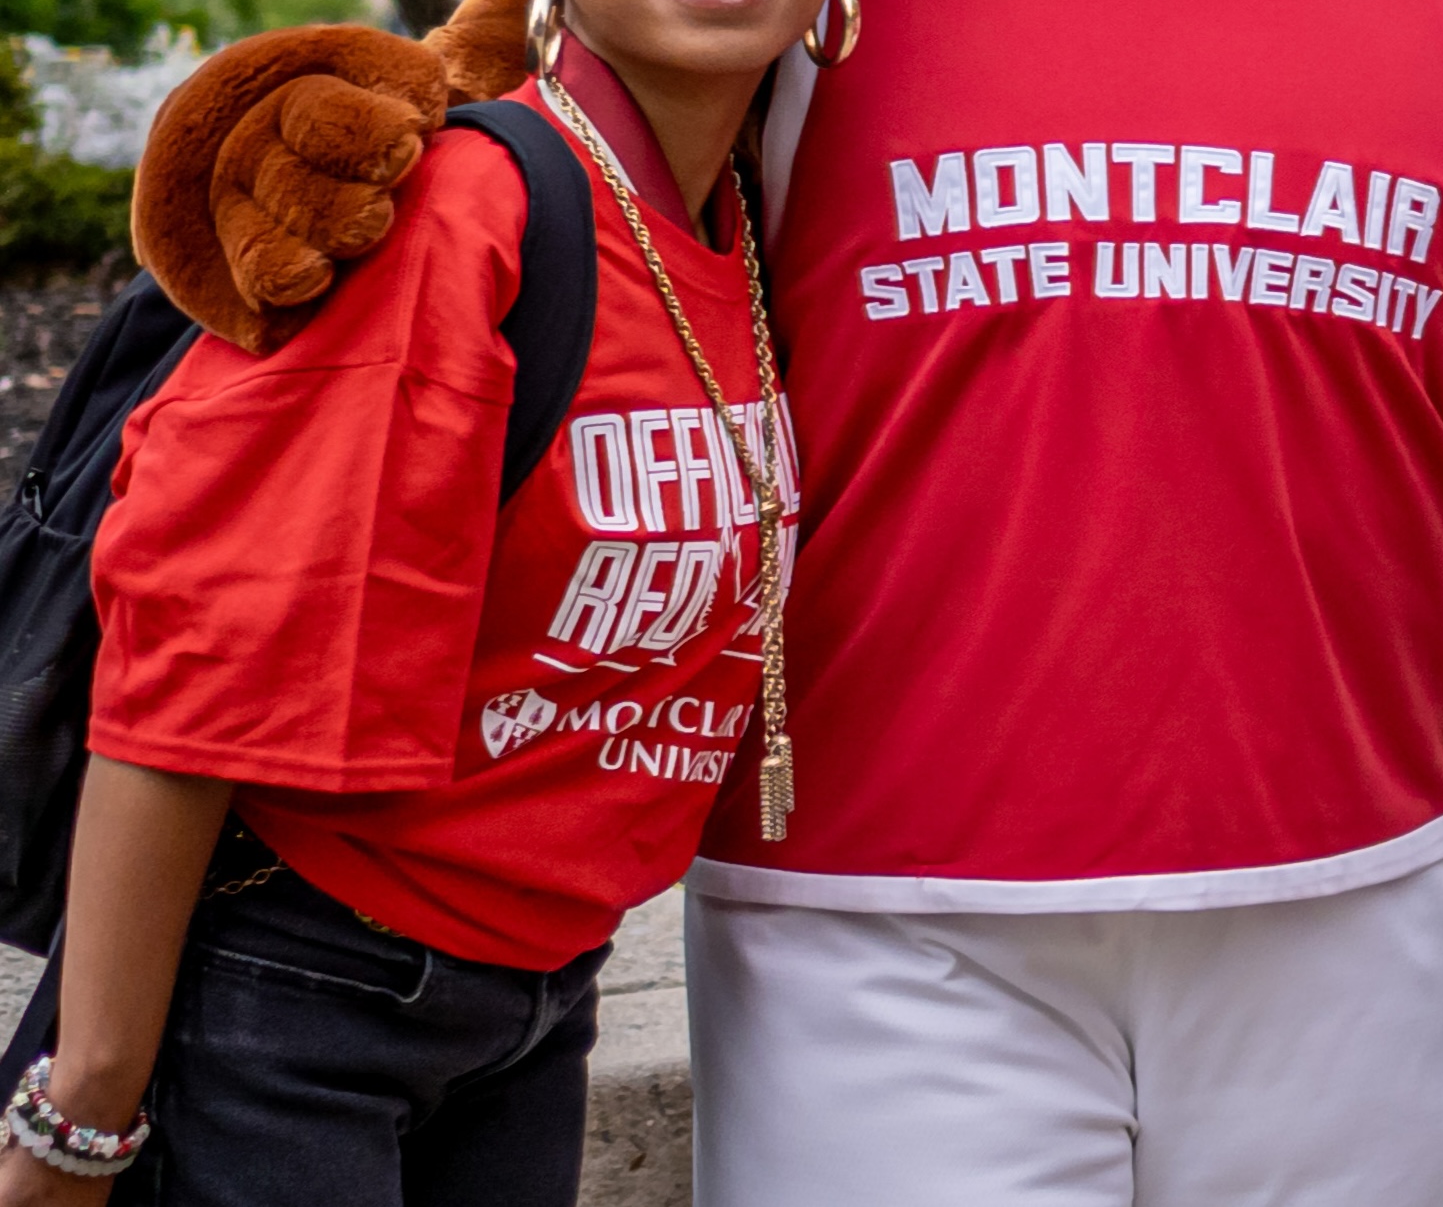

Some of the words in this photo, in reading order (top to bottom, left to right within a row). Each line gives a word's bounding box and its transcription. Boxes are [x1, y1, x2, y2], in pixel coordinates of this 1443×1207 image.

[889, 142, 1440, 263] MONTCLAIR
[860, 242, 1071, 320] STATE
[1094, 242, 1443, 340] UNIVERSITY
